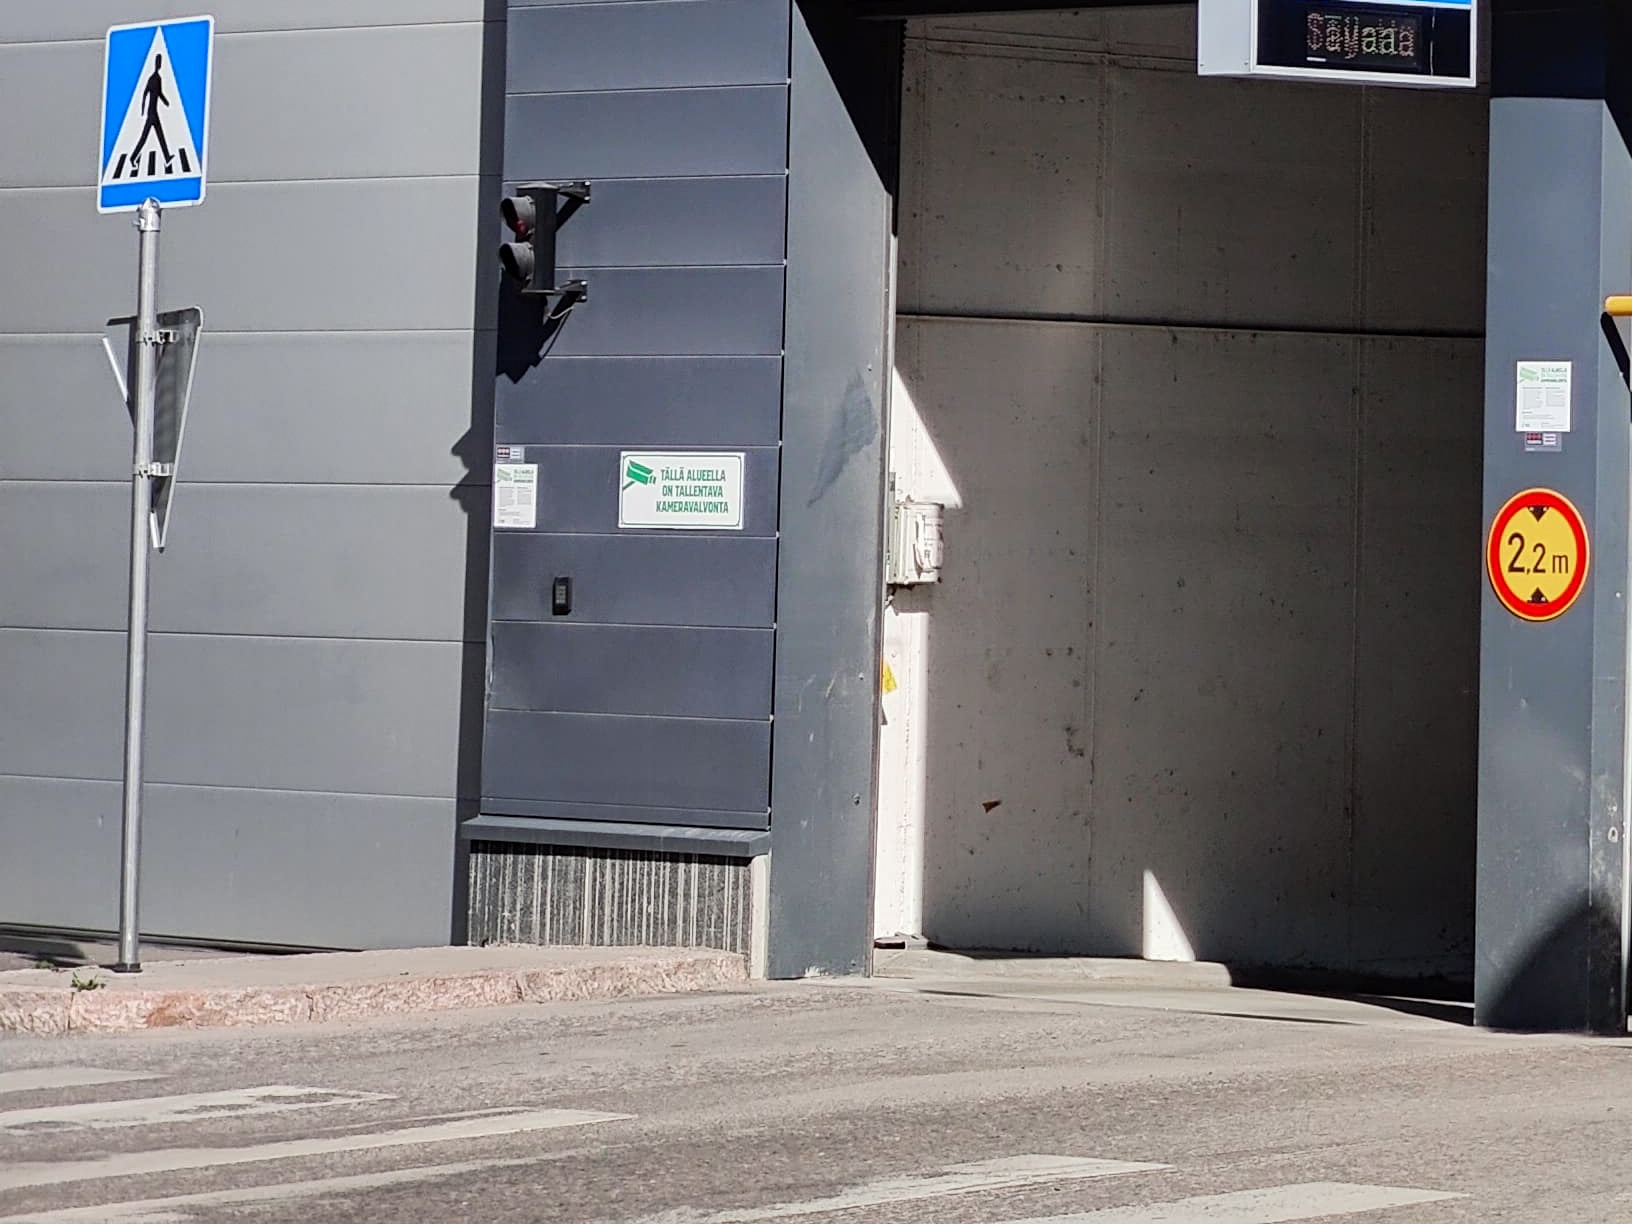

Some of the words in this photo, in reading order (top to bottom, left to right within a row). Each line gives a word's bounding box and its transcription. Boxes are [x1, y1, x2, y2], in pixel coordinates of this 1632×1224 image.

[660, 466, 685, 482] TÄLLÄ
[686, 469, 726, 482] ALUEELLA
[662, 485, 674, 497] ON
[675, 485, 723, 498] TALLENTAVA
[656, 501, 729, 514] KAMERAVALVONTA
[1507, 532, 1546, 575] 2,2
[1552, 553, 1569, 574] m
